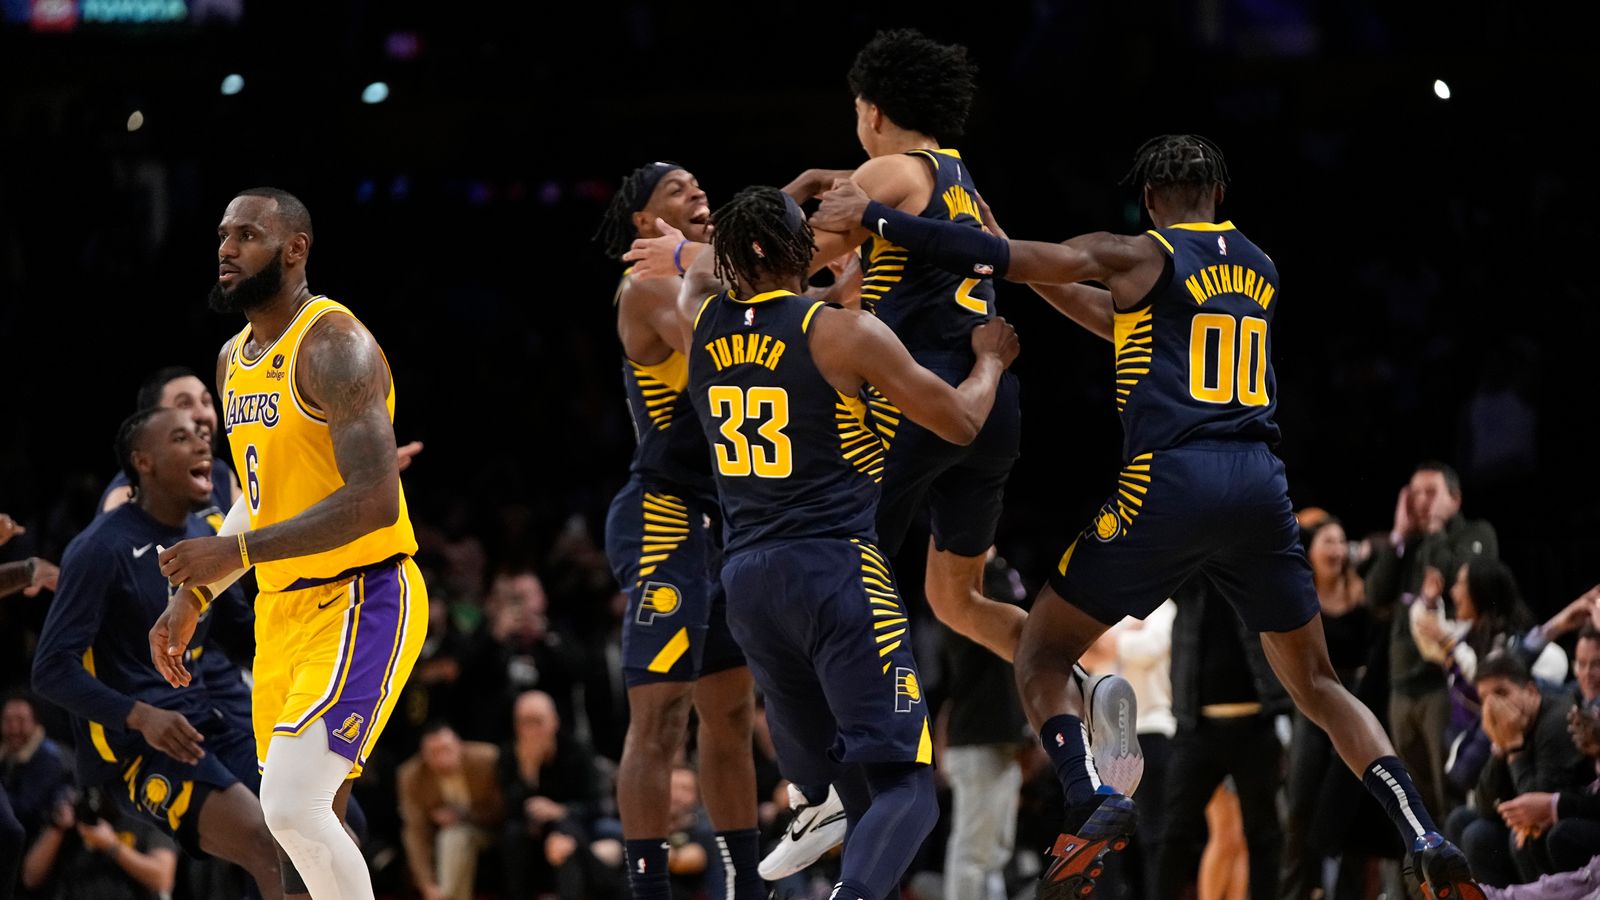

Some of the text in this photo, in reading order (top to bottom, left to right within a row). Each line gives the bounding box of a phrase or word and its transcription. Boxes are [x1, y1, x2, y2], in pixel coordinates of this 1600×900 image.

[1184, 263, 1276, 311] MATHURIN
[266, 370, 285, 381] bibigo
[704, 333, 786, 372] TURNER
[1189, 313, 1270, 407] 00
[225, 389, 281, 435] LAKERS
[708, 385, 793, 479] 33
[245, 444, 261, 516] 6
